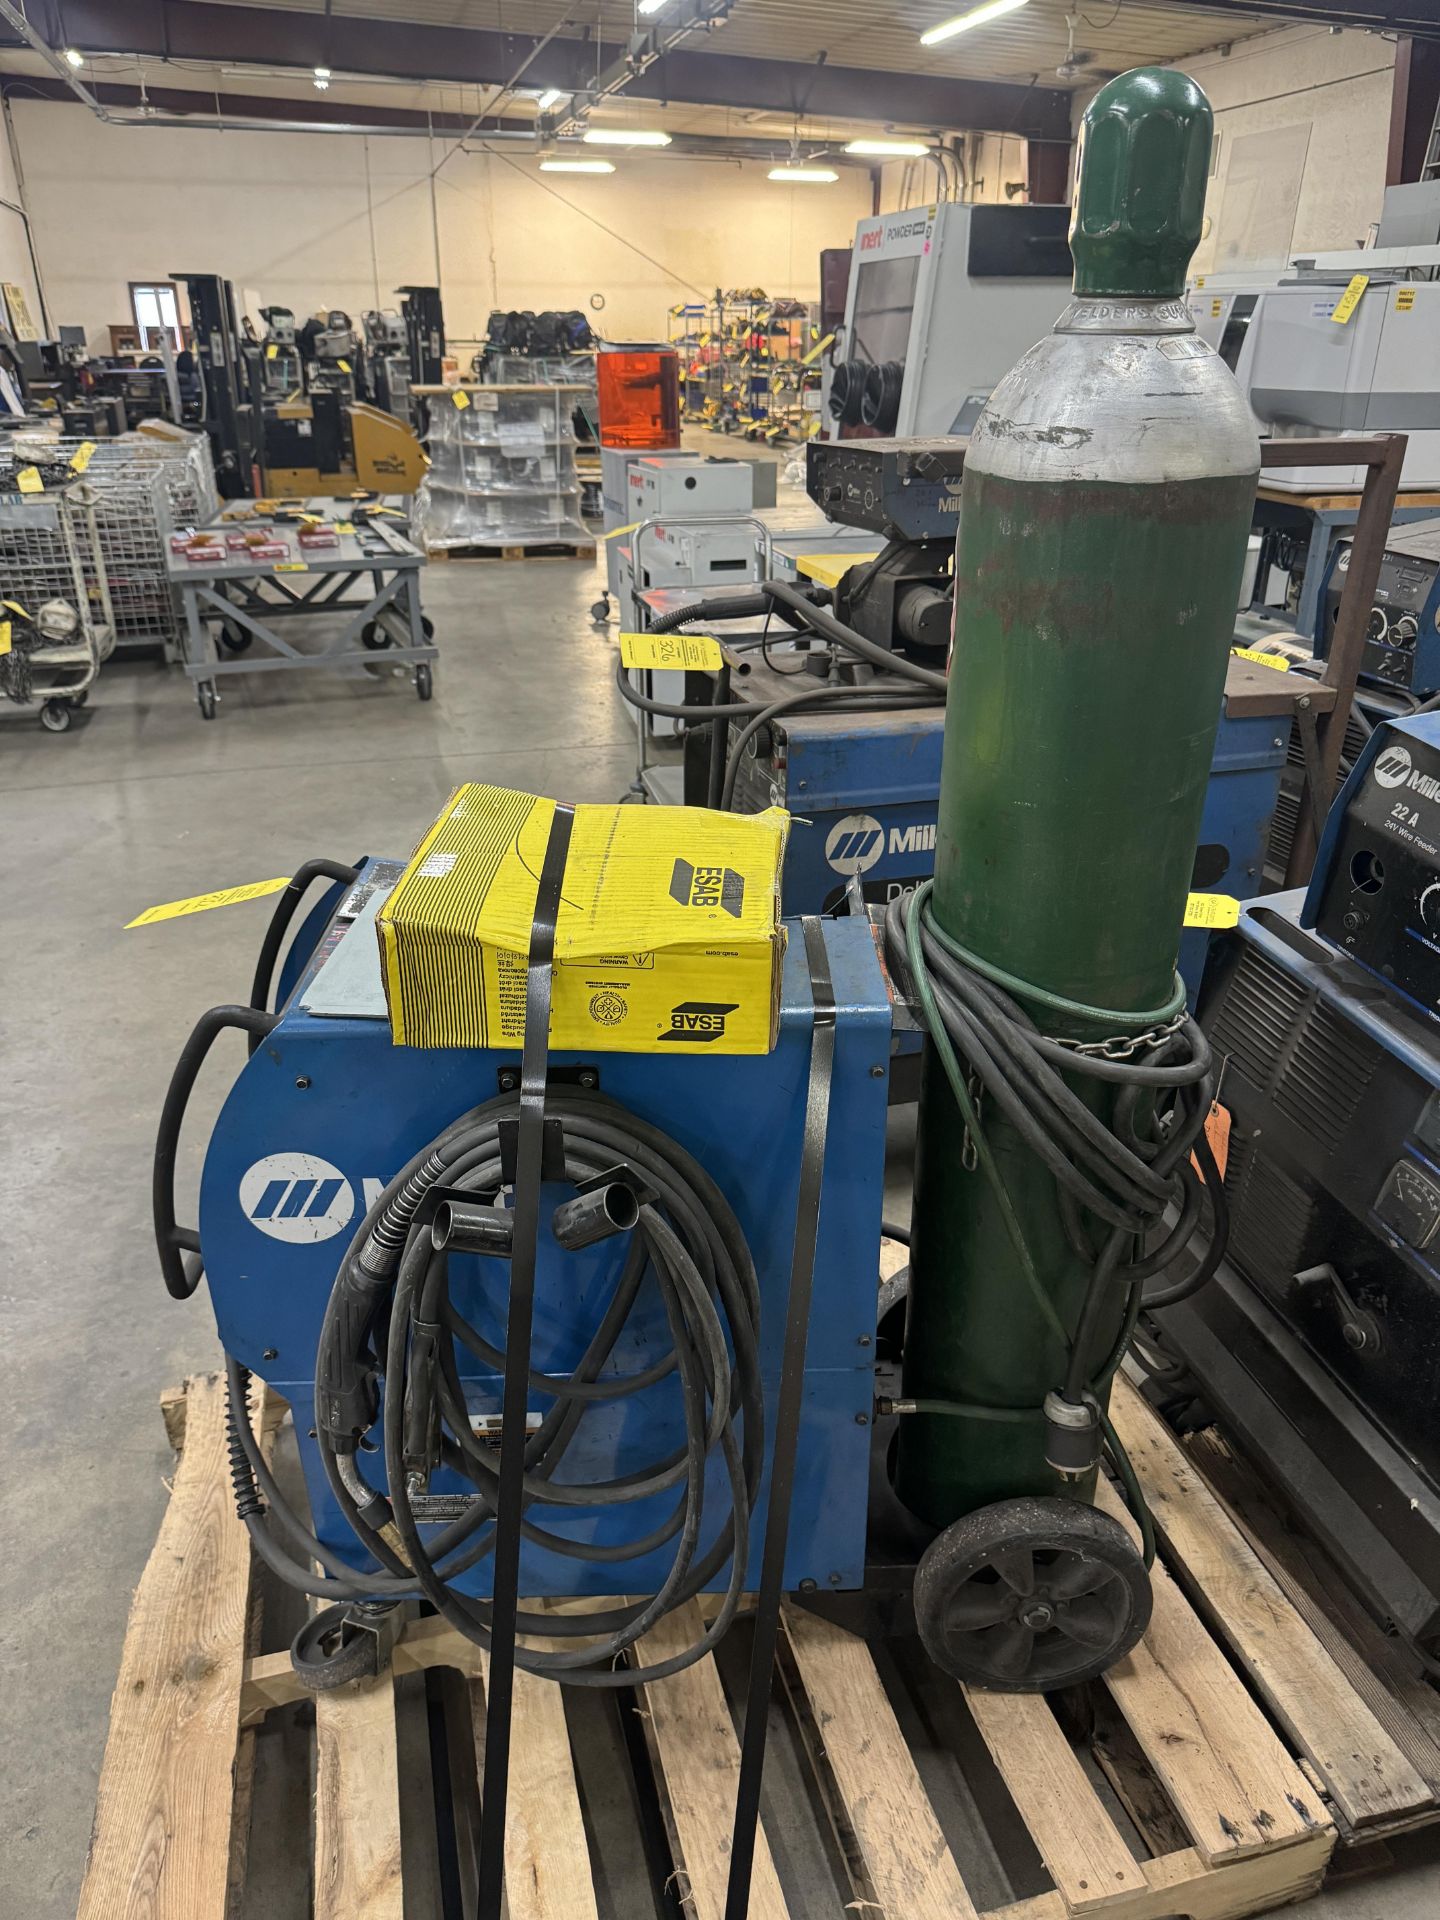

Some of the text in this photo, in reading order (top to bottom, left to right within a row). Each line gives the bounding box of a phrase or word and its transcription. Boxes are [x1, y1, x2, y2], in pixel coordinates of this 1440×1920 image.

[938, 496, 961, 513] Mill
[1406, 769, 1440, 804] Mille
[1390, 802, 1420, 828] 22 A
[888, 824, 937, 854] Mill
[1383, 819, 1438, 856] 24V Wire Feeder
[692, 866, 724, 907] ESAB
[705, 949, 740, 958] esab.com
[671, 1013, 725, 1031] ESAB
